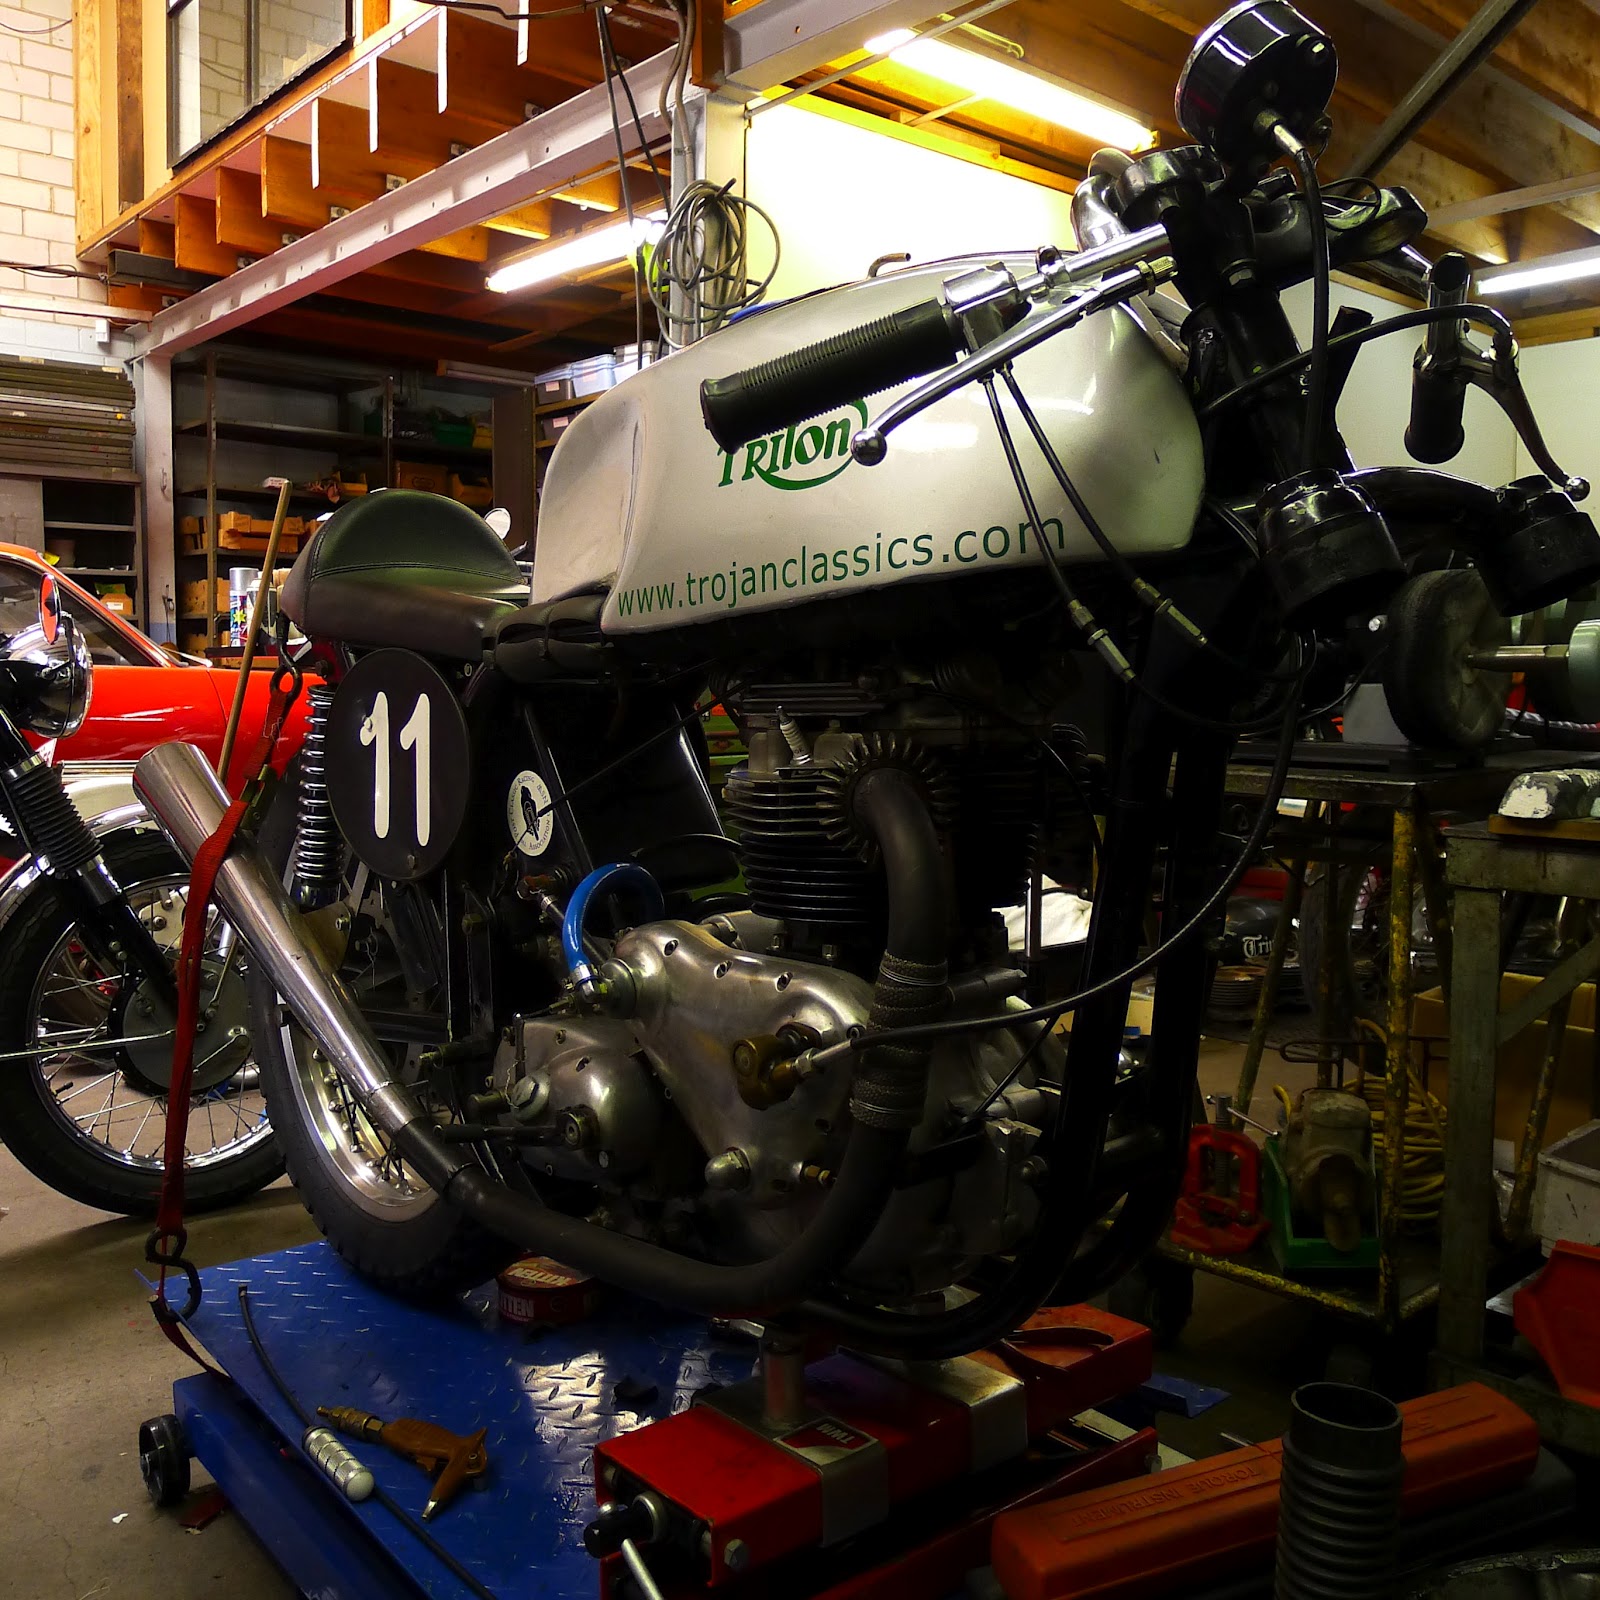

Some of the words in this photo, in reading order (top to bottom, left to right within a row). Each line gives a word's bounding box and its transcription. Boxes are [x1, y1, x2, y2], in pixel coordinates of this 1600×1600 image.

[618, 516, 1066, 616] www.trojanclassics.com
[360, 691, 430, 846] 11
[1072, 1488, 1185, 1527] INSTRUMENT
[1190, 1464, 1262, 1494] TORQUE
